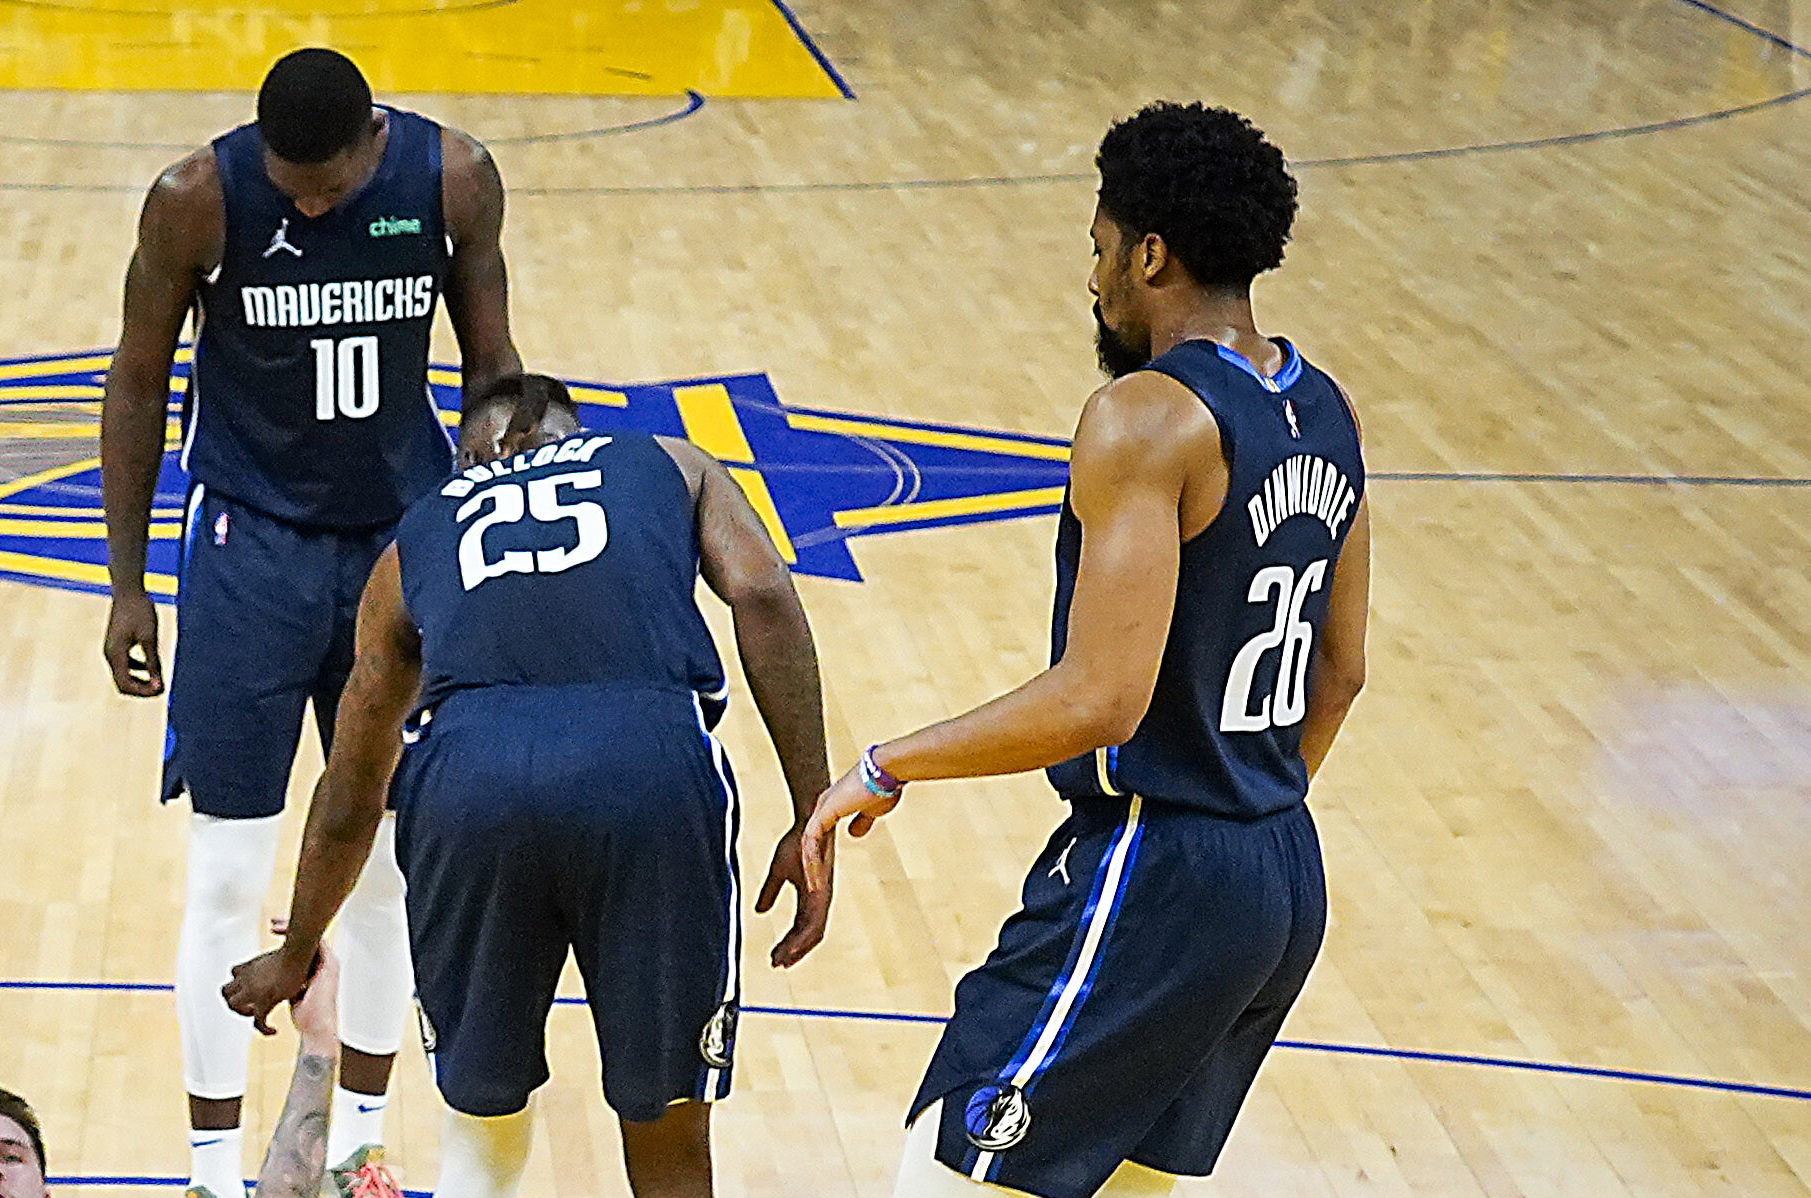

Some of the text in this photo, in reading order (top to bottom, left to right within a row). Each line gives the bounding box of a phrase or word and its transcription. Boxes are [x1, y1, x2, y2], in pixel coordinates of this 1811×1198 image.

[369, 215, 422, 238] chime
[242, 276, 432, 327] MAVERICKS
[310, 335, 380, 420] 10
[441, 436, 613, 497] BULLOCK
[1247, 454, 1356, 548] DINWIDDIE
[456, 469, 608, 592] 25
[1219, 559, 1329, 733] 26
